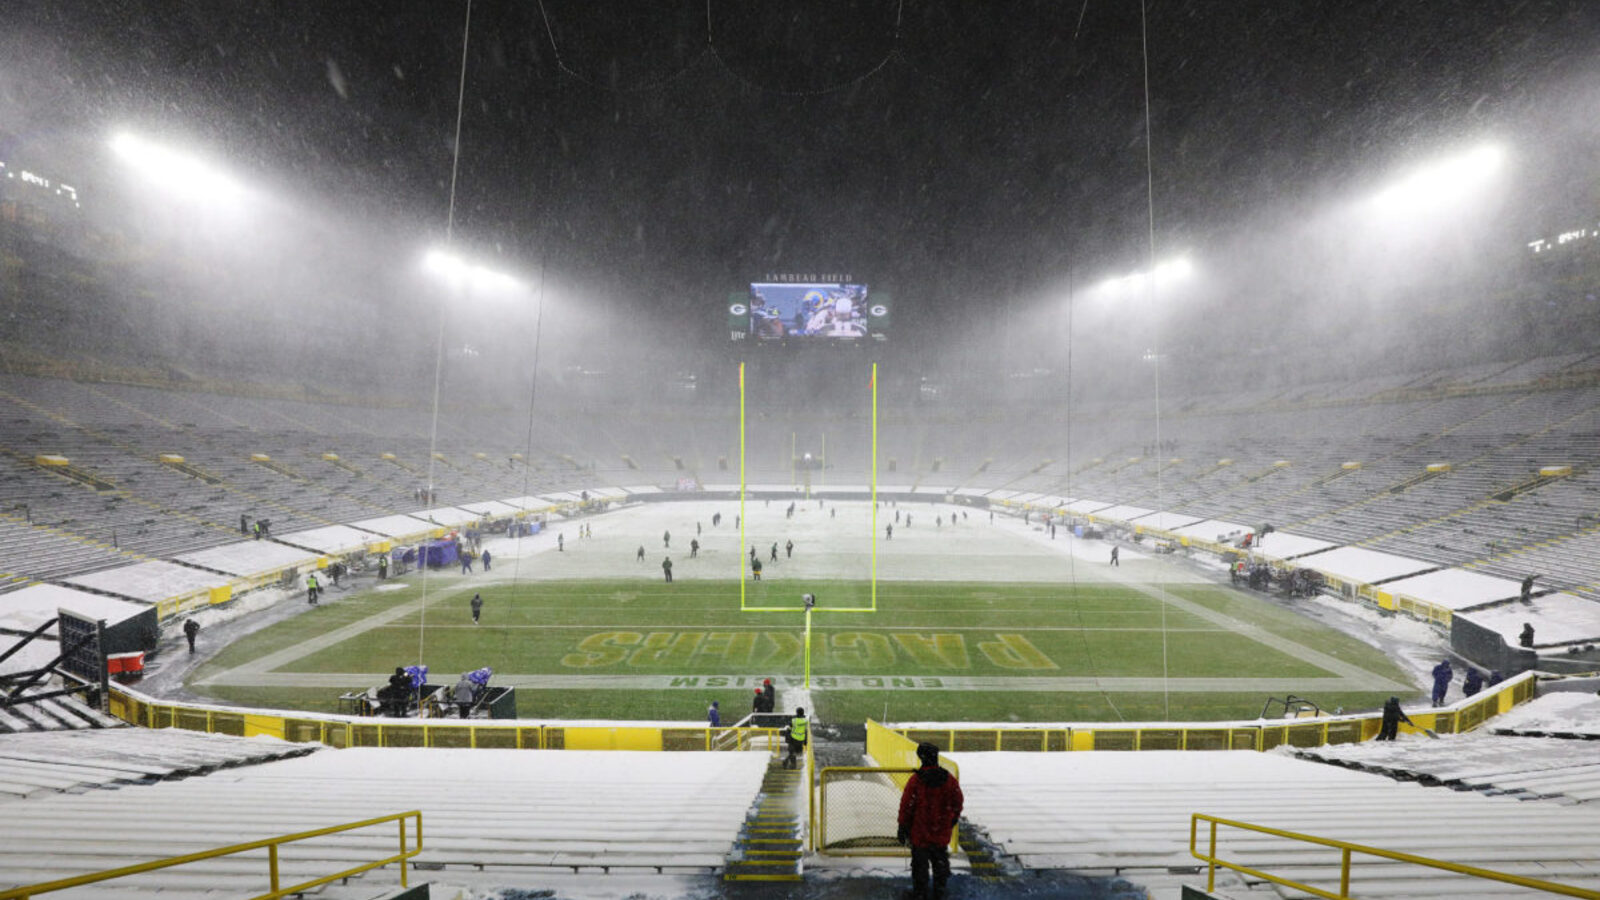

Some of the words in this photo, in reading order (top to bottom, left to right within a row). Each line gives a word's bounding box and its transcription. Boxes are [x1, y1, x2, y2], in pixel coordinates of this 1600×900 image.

[766, 273, 817, 282] LAMBEAU
[821, 273, 853, 282] FIELD
[729, 303, 747, 315] G
[870, 305, 887, 316] G
[560, 631, 1062, 669] PACKERS
[862, 677, 944, 689] END
